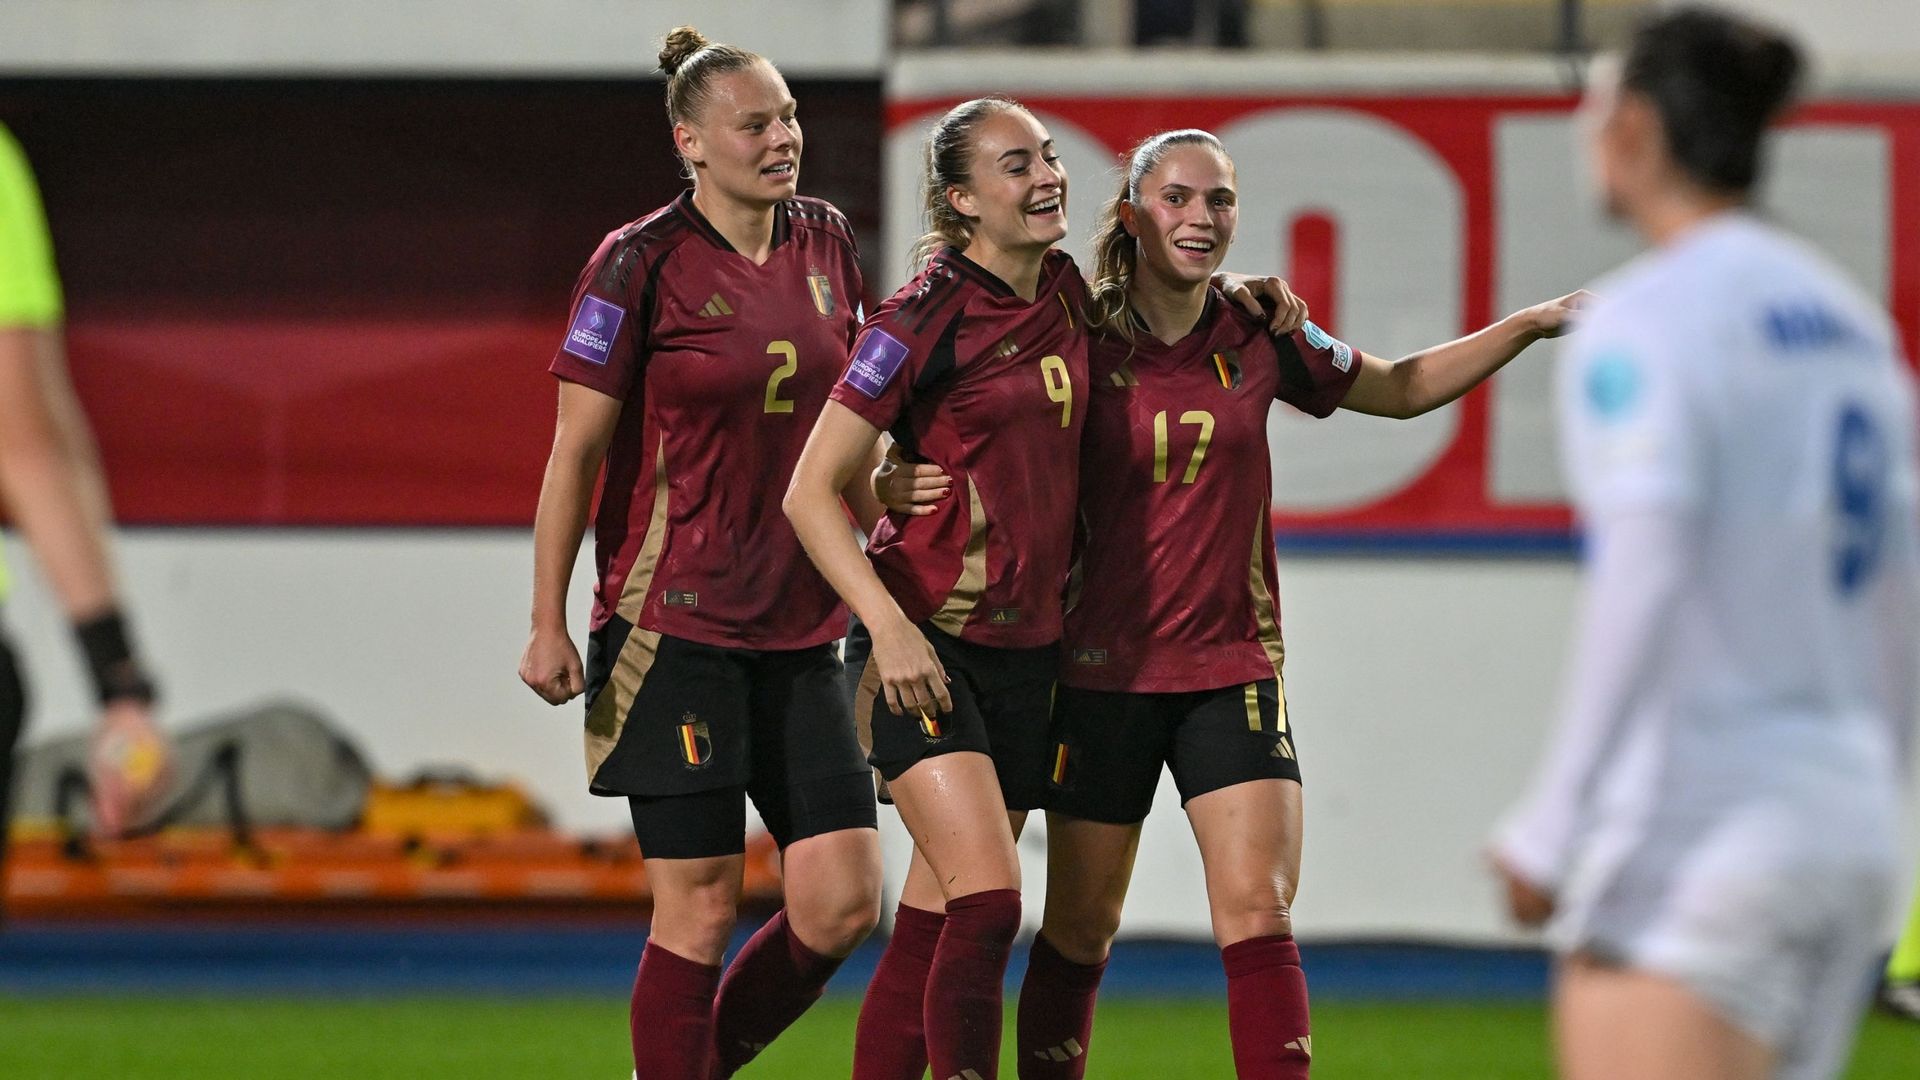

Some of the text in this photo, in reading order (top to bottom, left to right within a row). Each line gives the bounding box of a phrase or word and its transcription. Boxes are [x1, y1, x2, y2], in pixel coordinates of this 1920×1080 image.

[571, 334, 608, 353] QUALIFIERS
[574, 329, 608, 347] EUROPEAN
[764, 340, 798, 413] 2
[851, 364, 883, 387] QUALIFIERS
[855, 359, 885, 382] EUROPEAN
[1041, 355, 1073, 428] 9
[1153, 410, 1216, 484] 17
